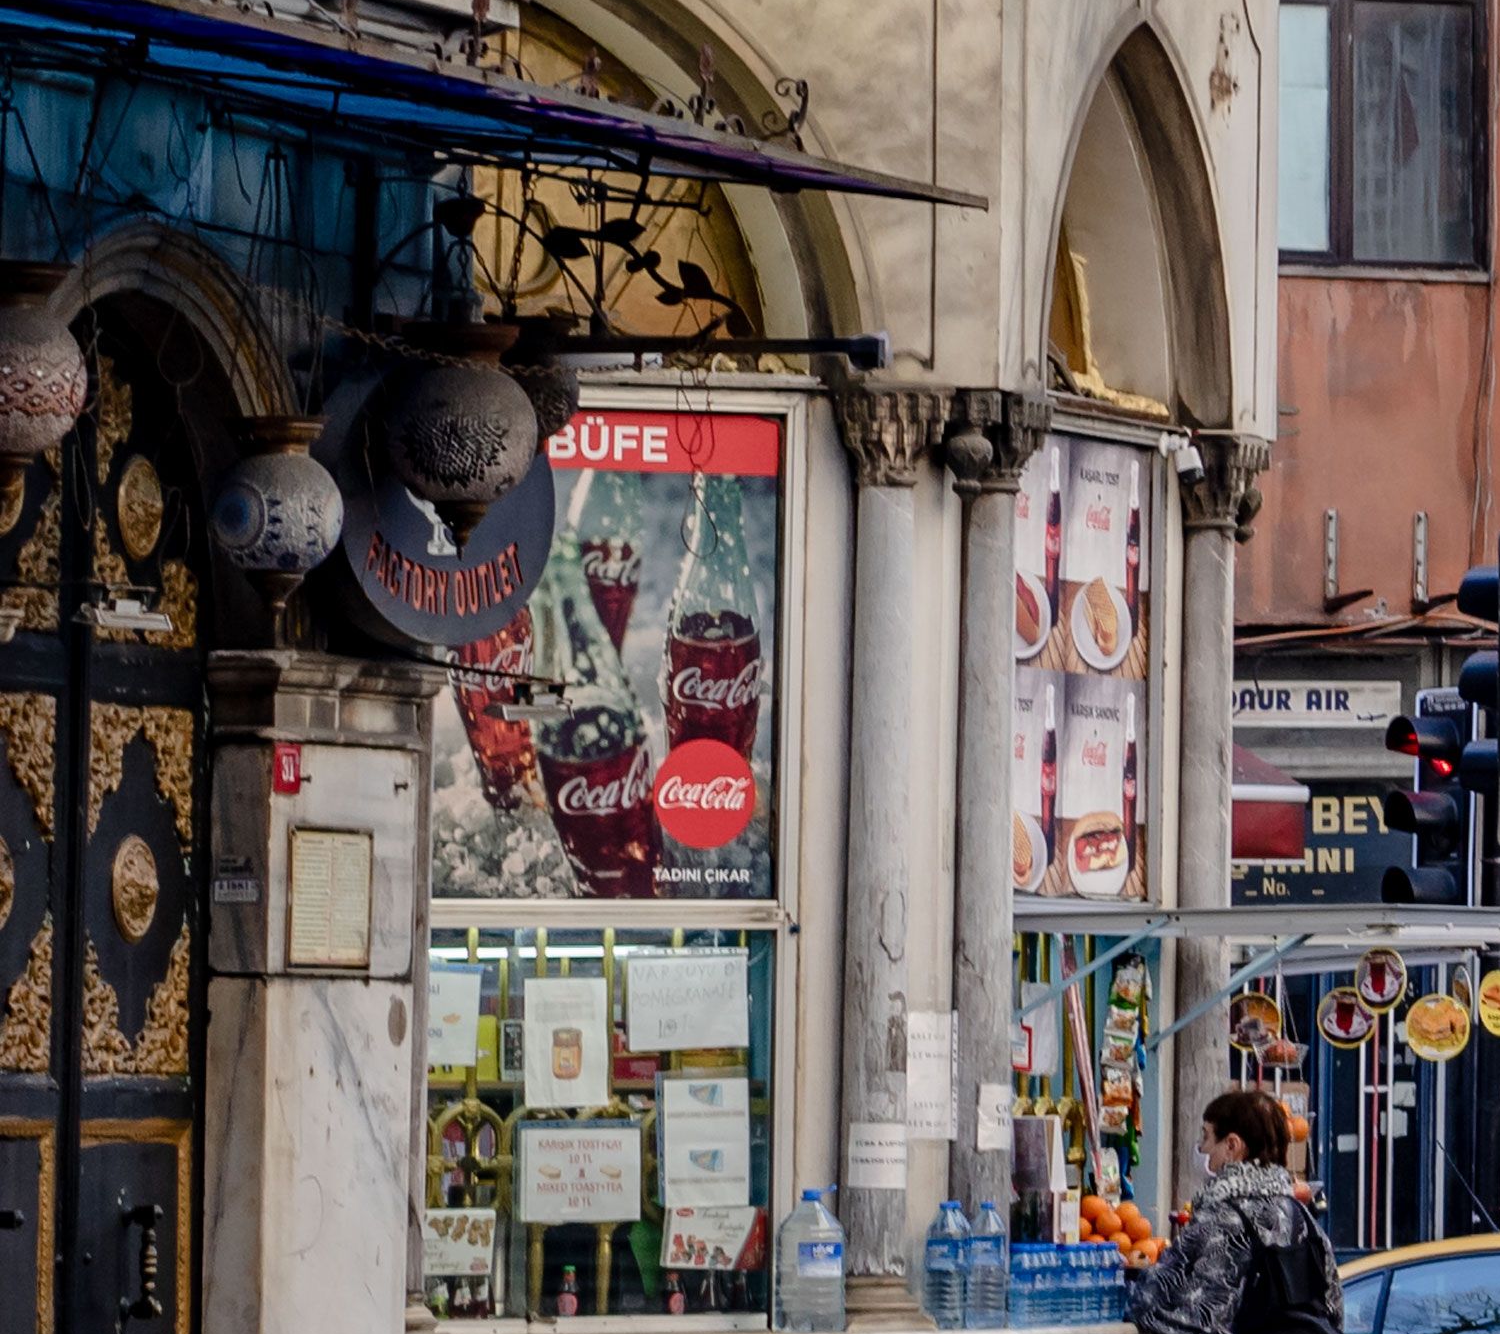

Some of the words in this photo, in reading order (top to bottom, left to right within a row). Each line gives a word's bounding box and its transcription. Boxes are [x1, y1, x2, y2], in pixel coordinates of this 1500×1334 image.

[547, 416, 669, 464] BÜFE
[367, 530, 449, 616] FACTORY
[453, 542, 527, 618] OUTLET
[1306, 688, 1351, 711] AIR
[658, 775, 750, 812] Coca-Cola
[653, 866, 701, 883] TADINI
[704, 868, 750, 885] ÇIKAR
[537, 1181, 569, 1194] MIXED
